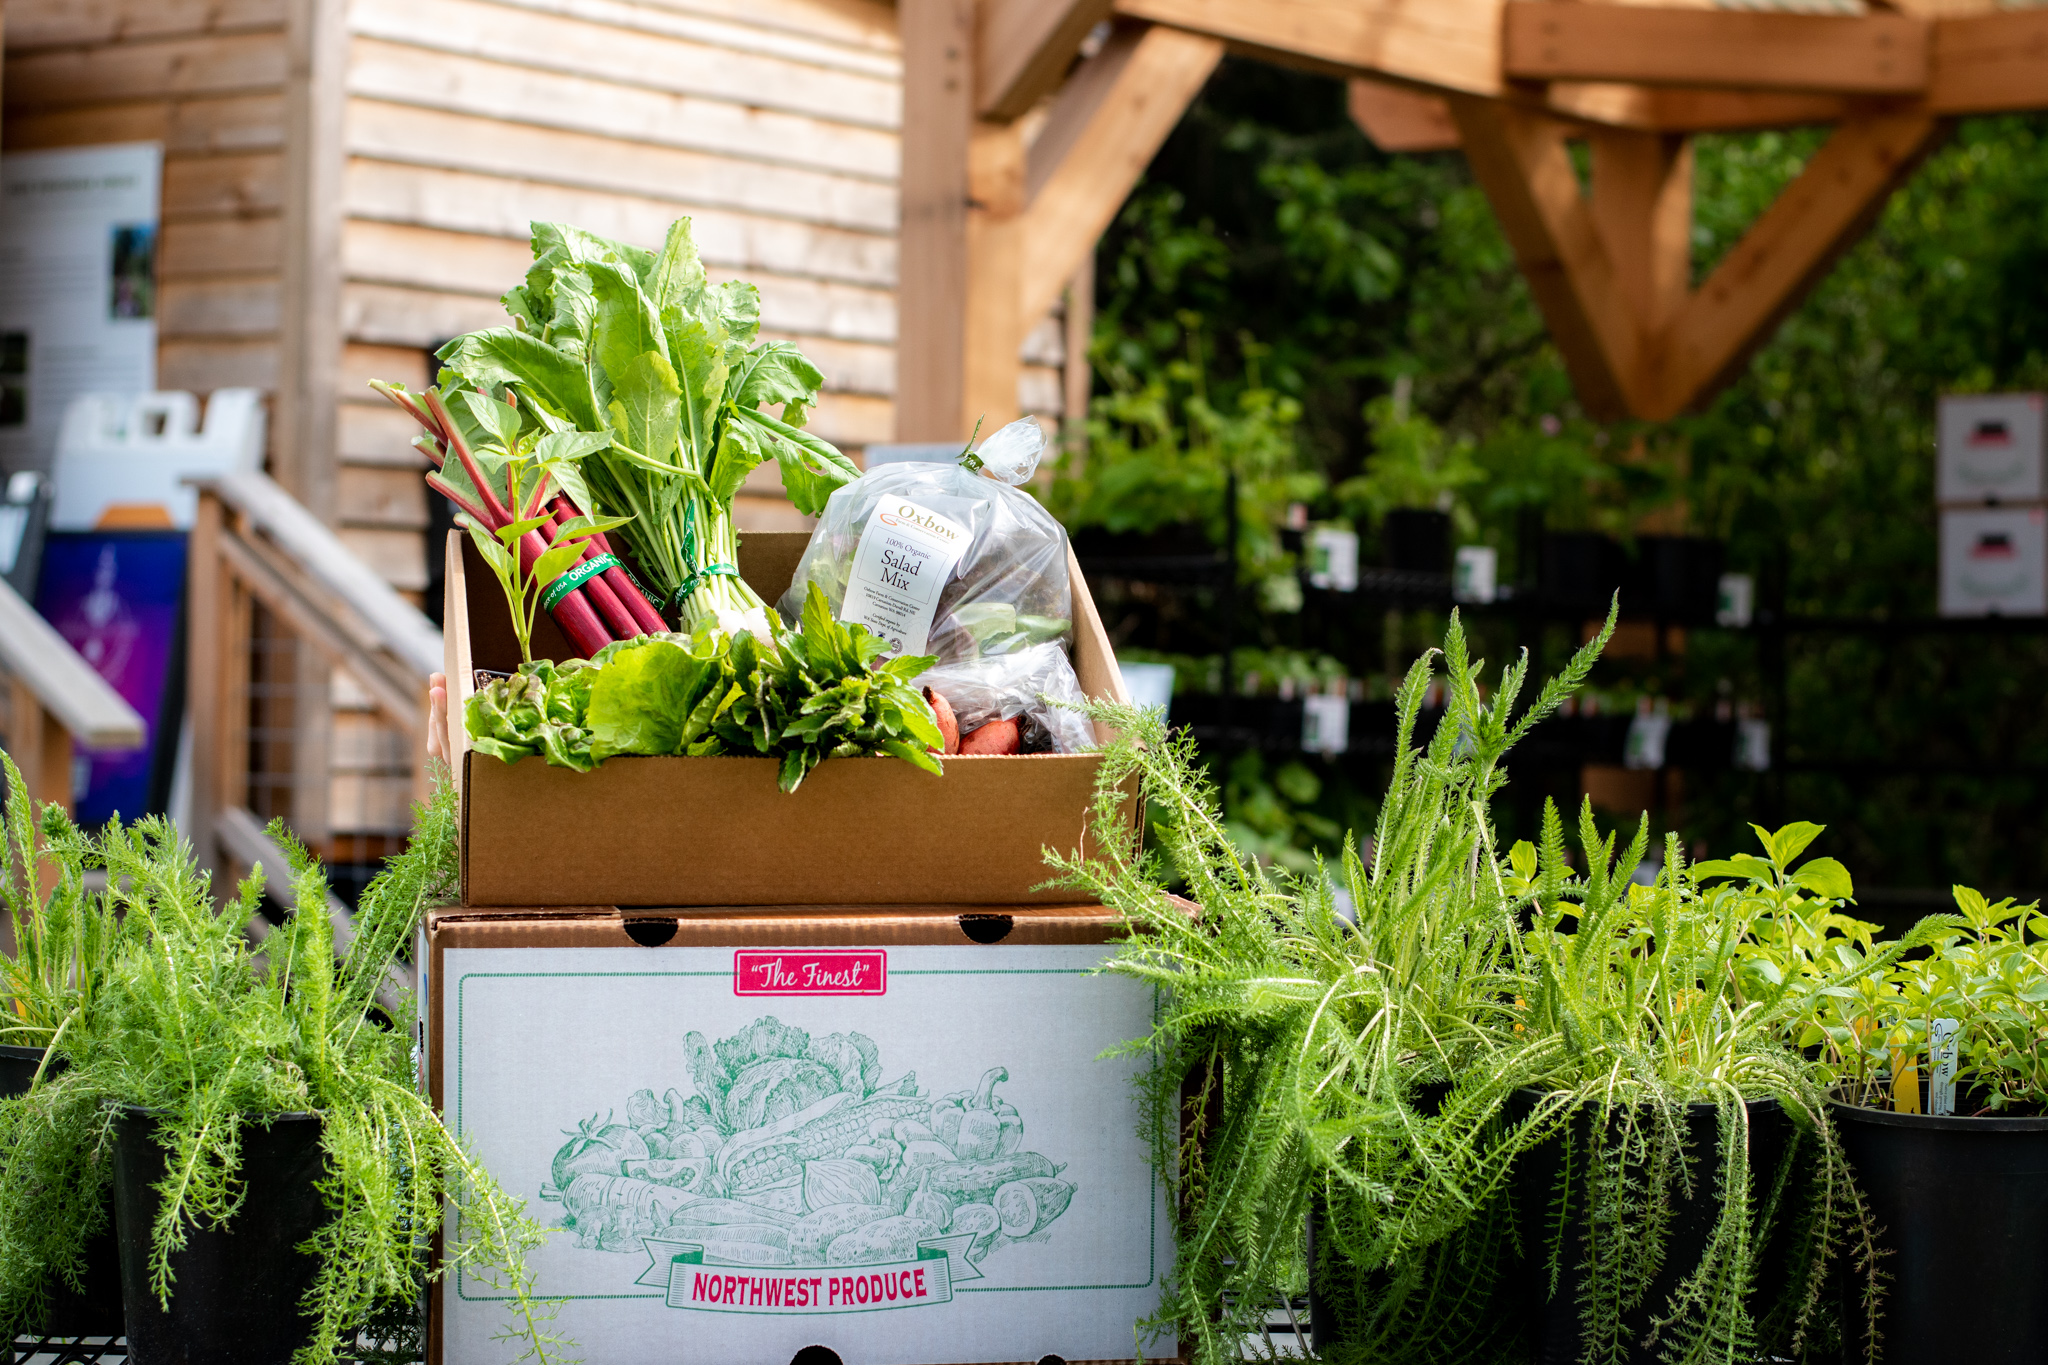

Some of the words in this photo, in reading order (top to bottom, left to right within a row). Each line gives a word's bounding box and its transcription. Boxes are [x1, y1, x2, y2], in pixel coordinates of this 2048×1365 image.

[898, 505, 959, 540] Oxbow
[885, 537, 904, 549] 100%
[904, 544, 931, 560] Organic
[569, 554, 612, 581] ORGANIC
[881, 549, 922, 576] Salad
[556, 581, 567, 592] USA
[880, 567, 910, 591] Mix
[692, 1272, 822, 1307] NORTHWEST
[828, 1267, 927, 1306] PRODUCE
